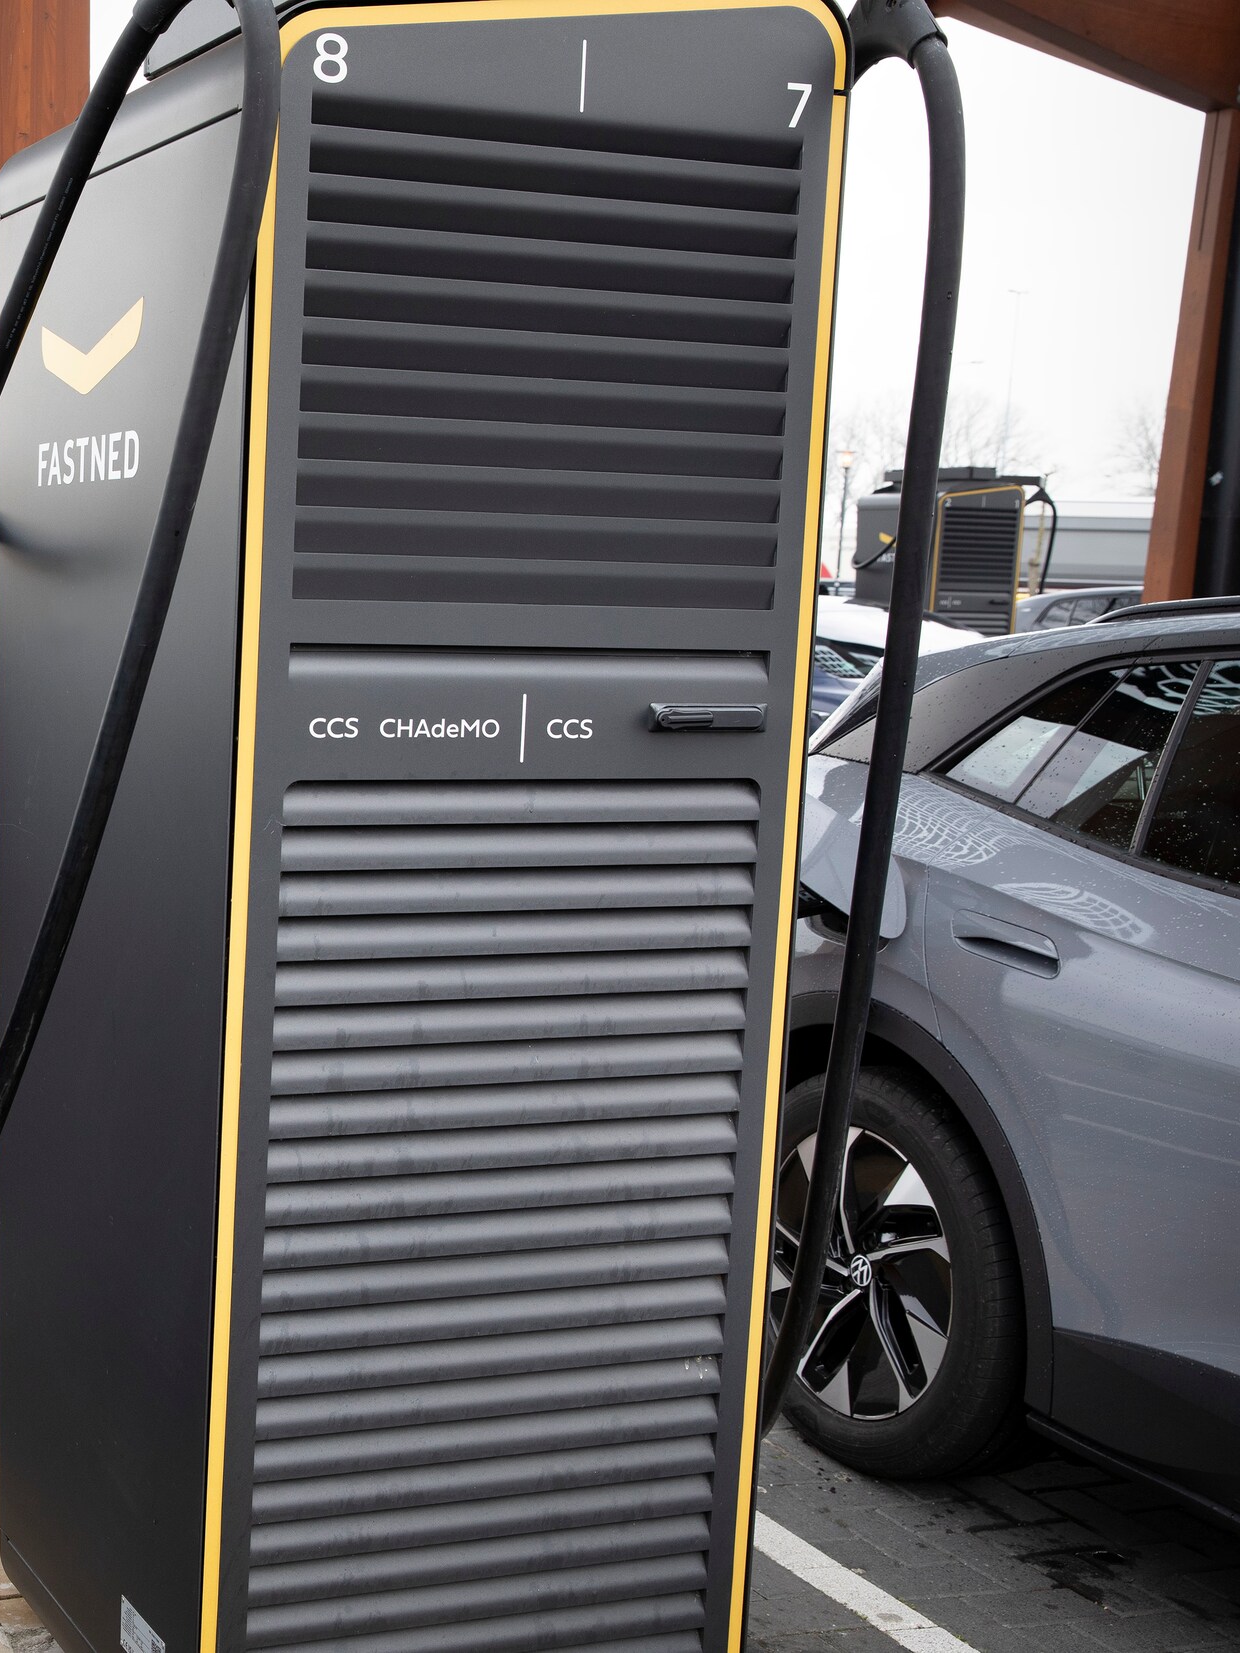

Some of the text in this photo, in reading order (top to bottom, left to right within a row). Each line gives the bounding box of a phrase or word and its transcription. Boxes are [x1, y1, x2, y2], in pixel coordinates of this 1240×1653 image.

[313, 33, 349, 84] 8
[787, 83, 813, 129] 7
[38, 430, 140, 487] FASTNED
[308, 717, 593, 740] CCS CHAdeMO CCS
